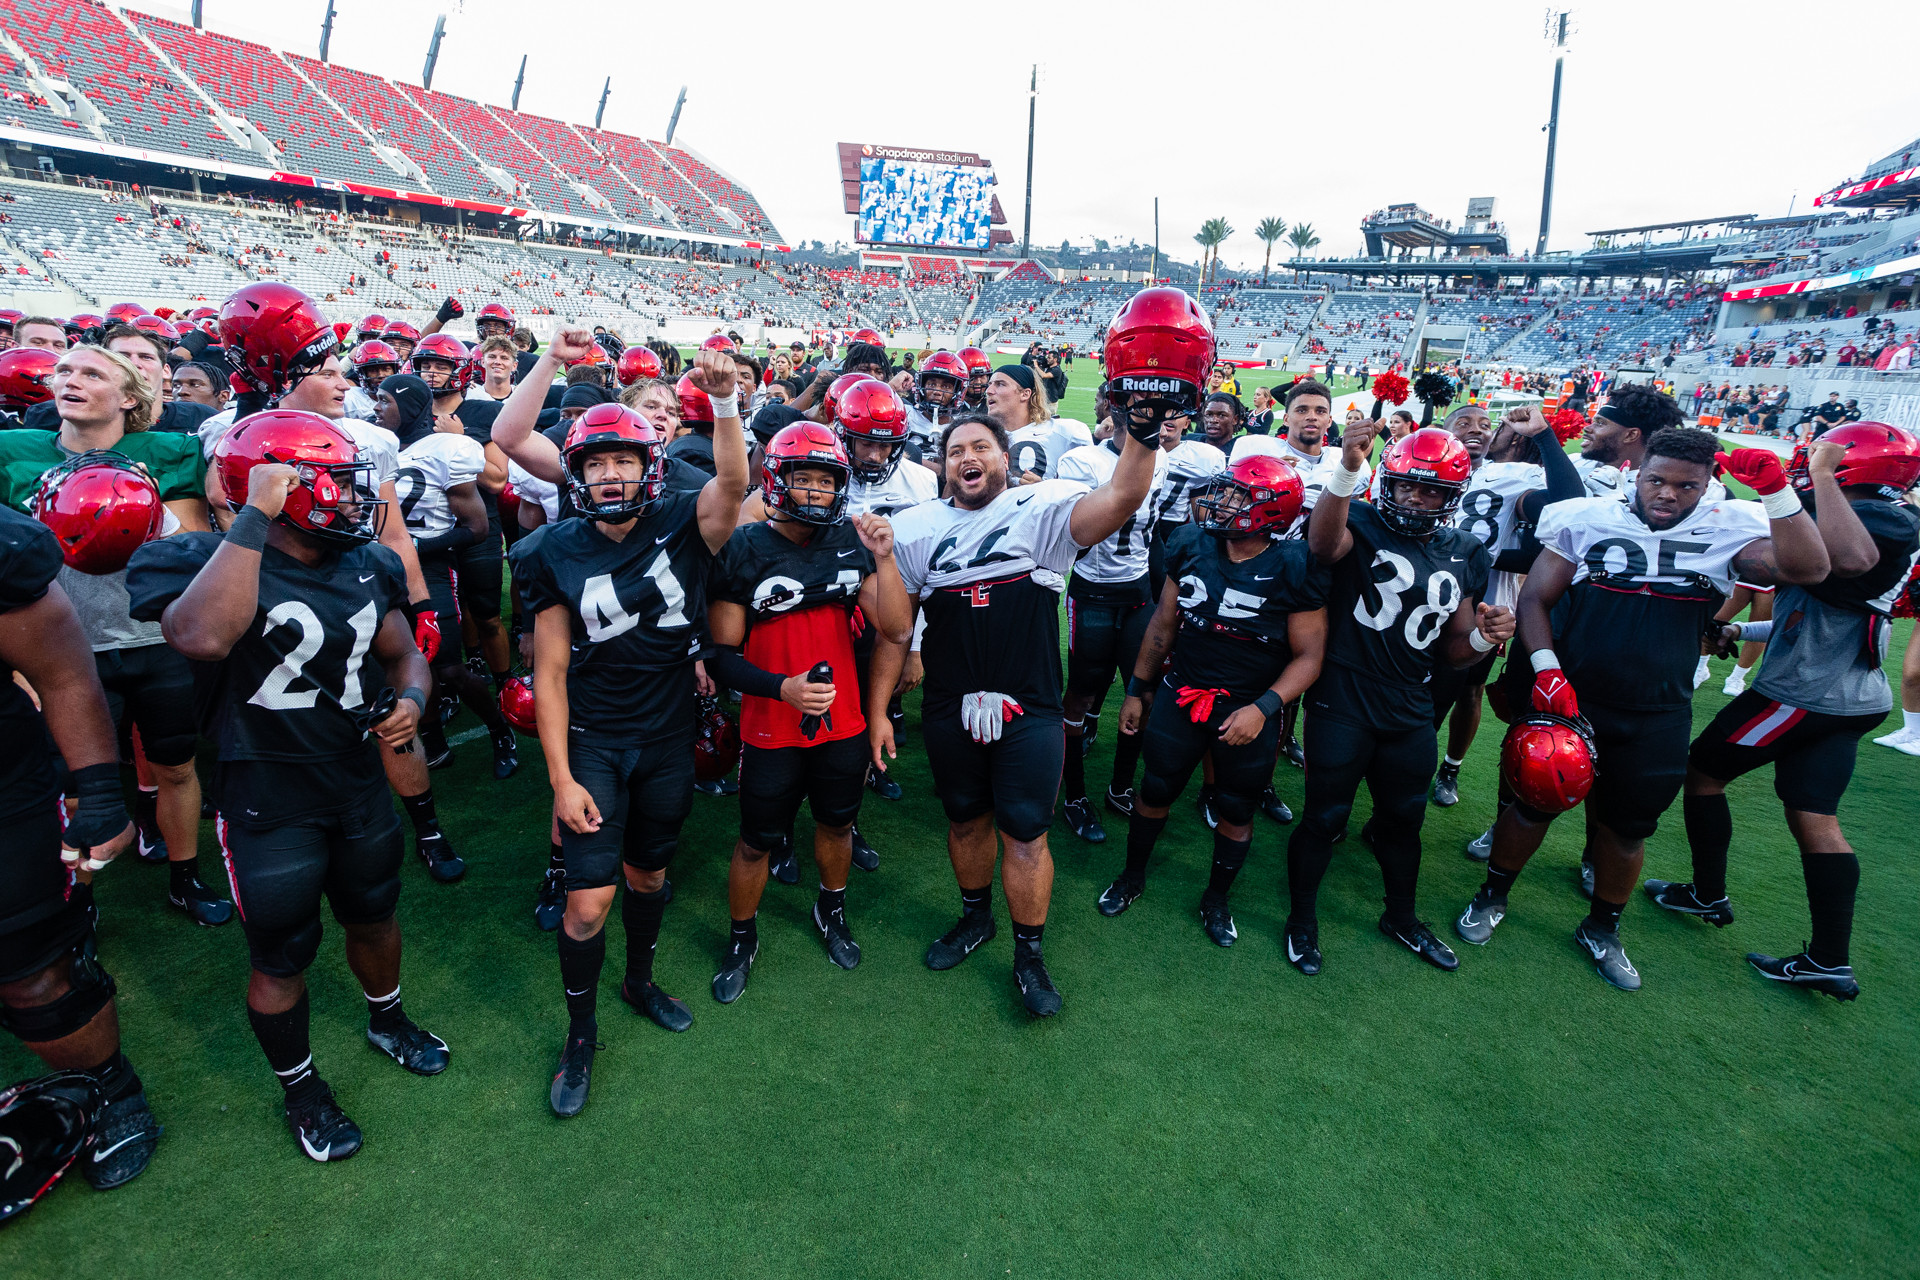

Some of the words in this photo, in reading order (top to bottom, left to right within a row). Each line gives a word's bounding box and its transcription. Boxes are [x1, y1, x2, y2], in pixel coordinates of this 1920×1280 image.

[875, 146, 934, 162] Snapdragon
[936, 153, 974, 164] stadium
[305, 333, 336, 358] Ridde
[1147, 358, 1158, 366] 66
[1122, 377, 1180, 393] Riddell
[871, 428, 893, 436] Riddell
[811, 449, 836, 460] Riddell
[1410, 467, 1437, 477] Riddell
[580, 548, 691, 643] 41
[1353, 549, 1461, 650] 38
[246, 599, 378, 710] 21
